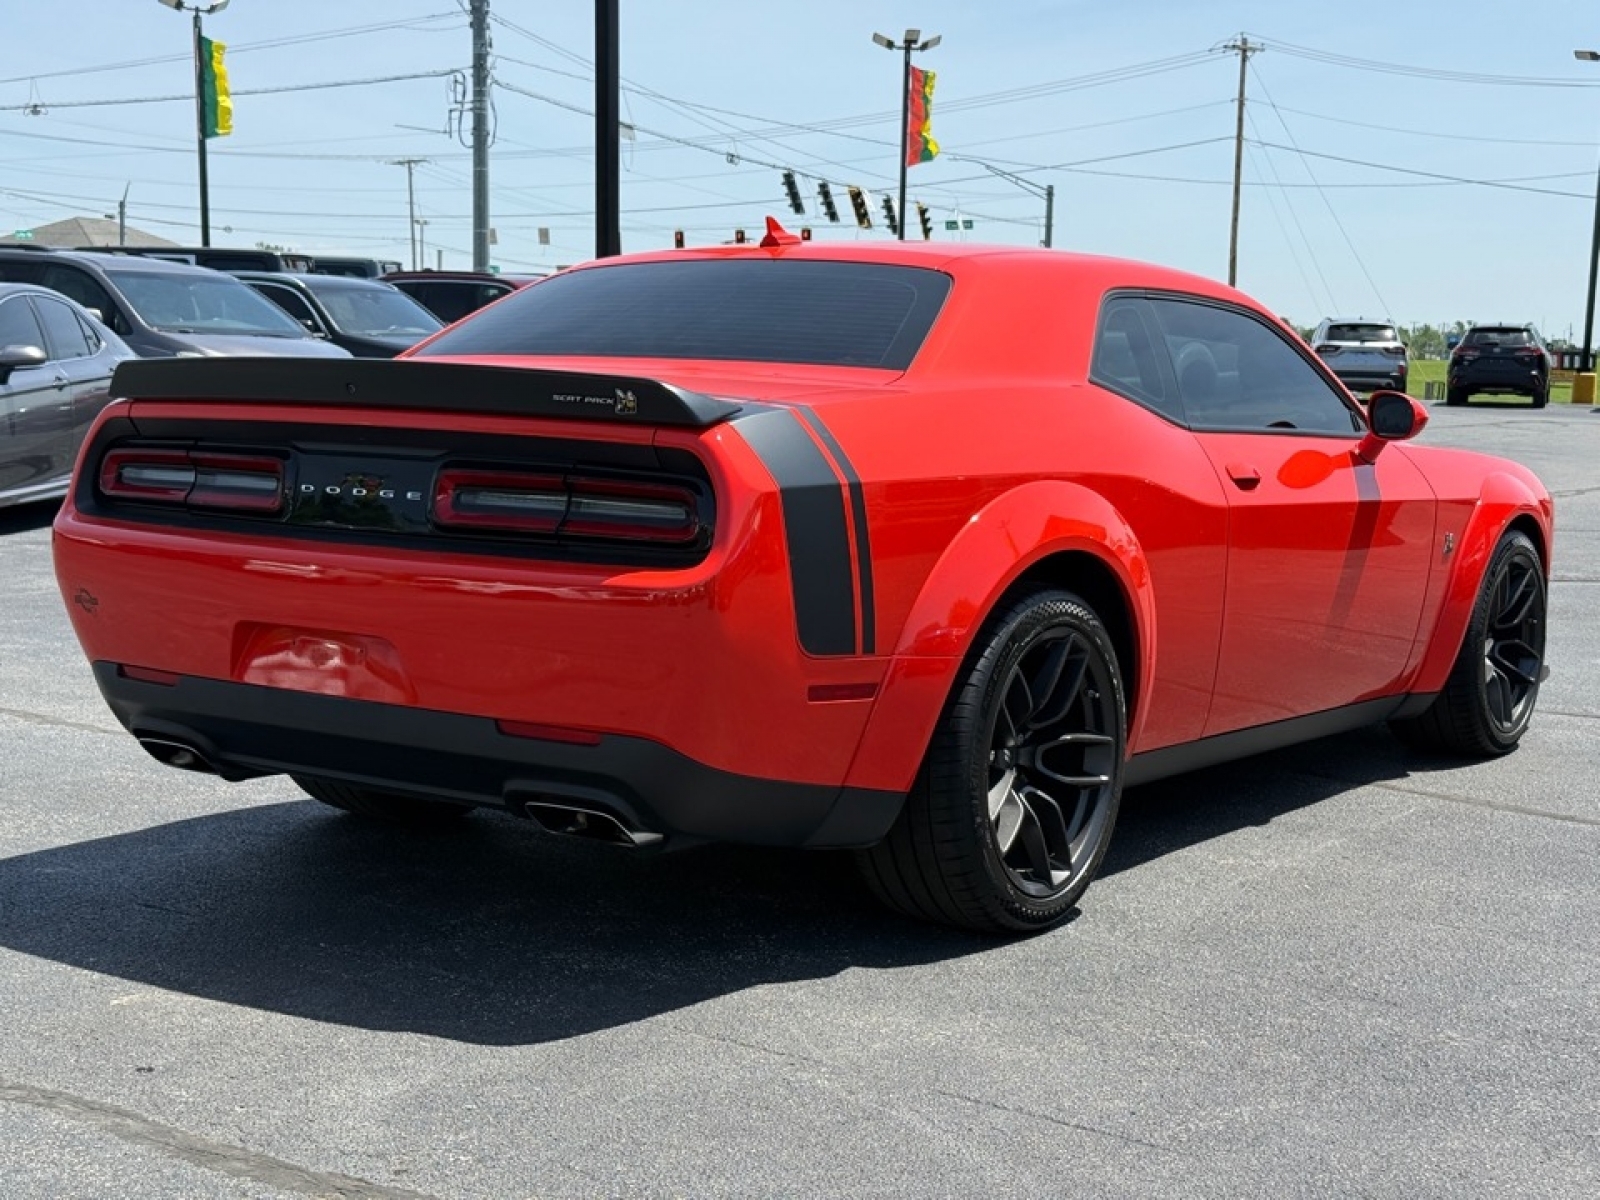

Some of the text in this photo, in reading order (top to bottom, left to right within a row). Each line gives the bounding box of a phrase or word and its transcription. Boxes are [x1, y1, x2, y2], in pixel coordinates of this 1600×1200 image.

[552, 394, 616, 405] SCAT PACK
[300, 483, 422, 501] DODGE
